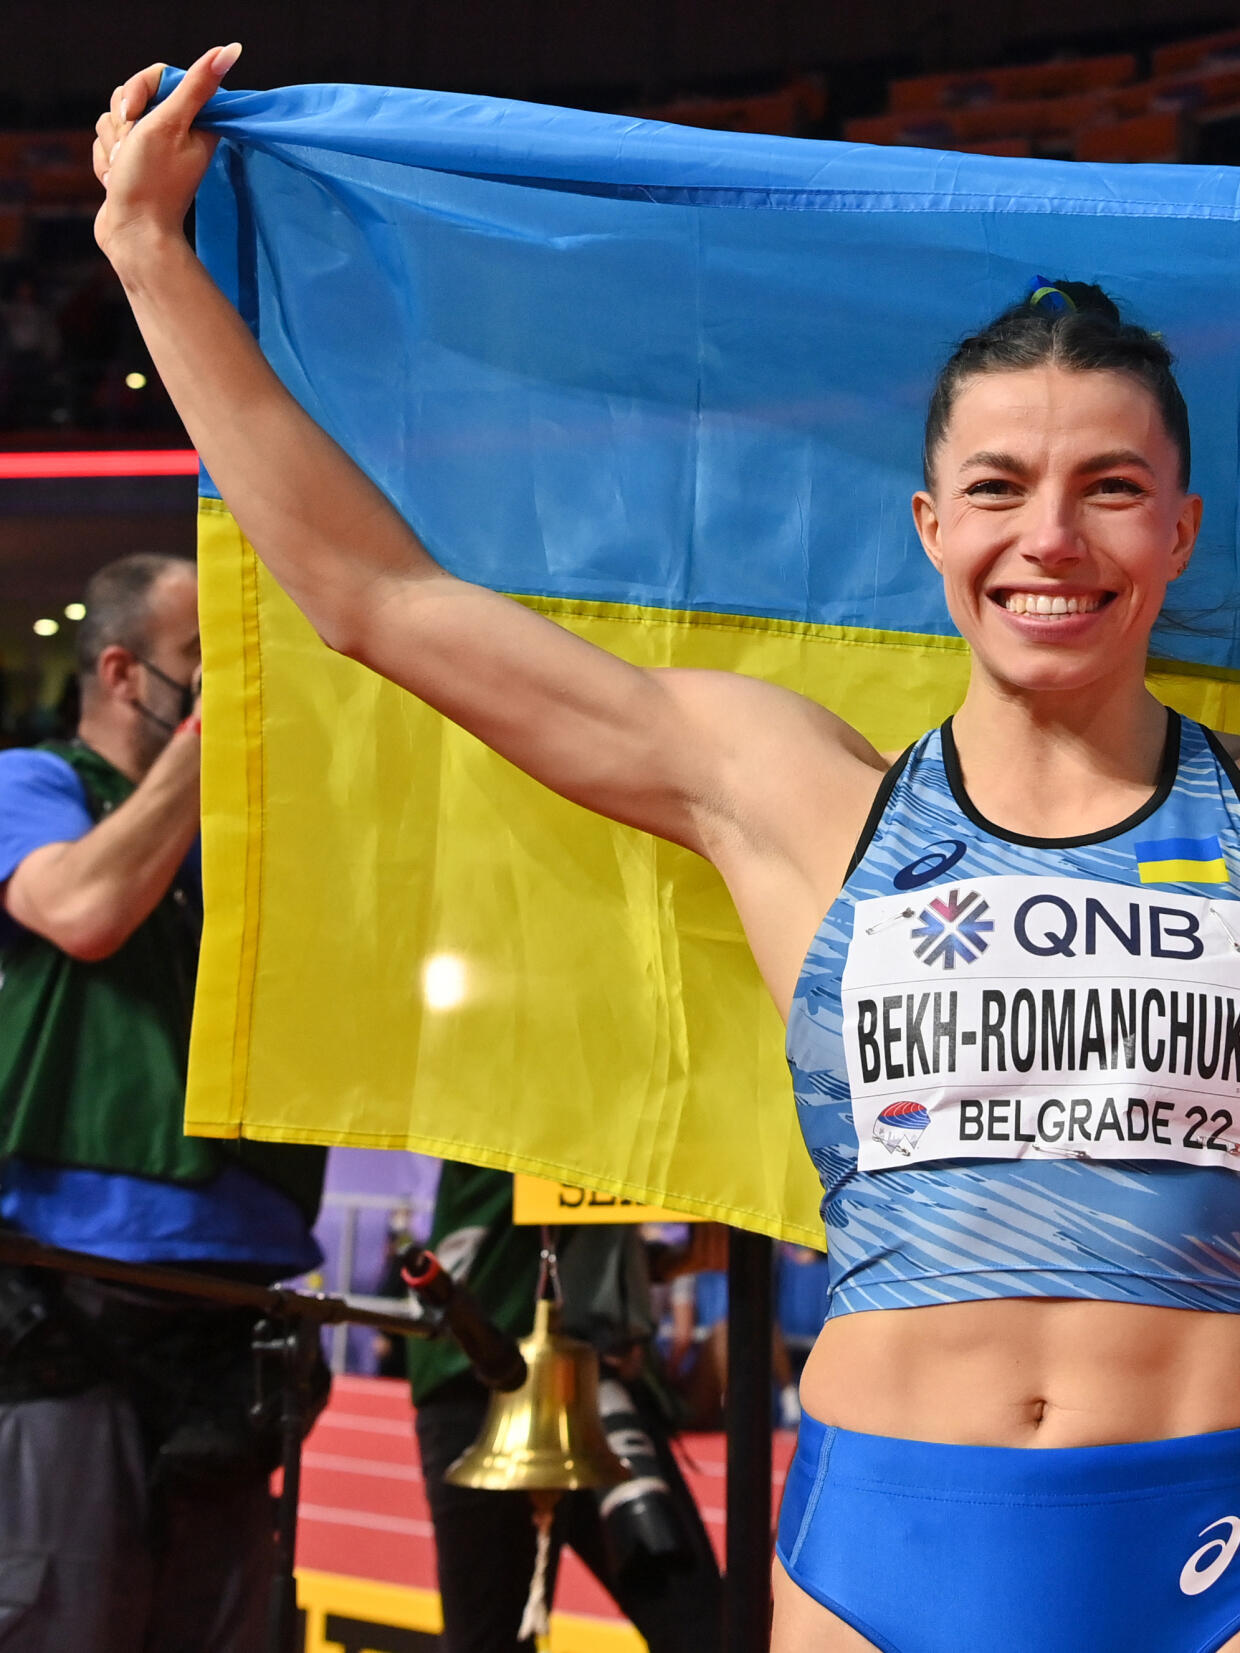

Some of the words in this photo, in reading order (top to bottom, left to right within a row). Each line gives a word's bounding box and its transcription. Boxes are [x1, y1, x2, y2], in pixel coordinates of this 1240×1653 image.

[1013, 893, 1204, 960] QNB
[959, 1097, 1175, 1145] BELGRADE
[1182, 1105, 1233, 1150] 22
